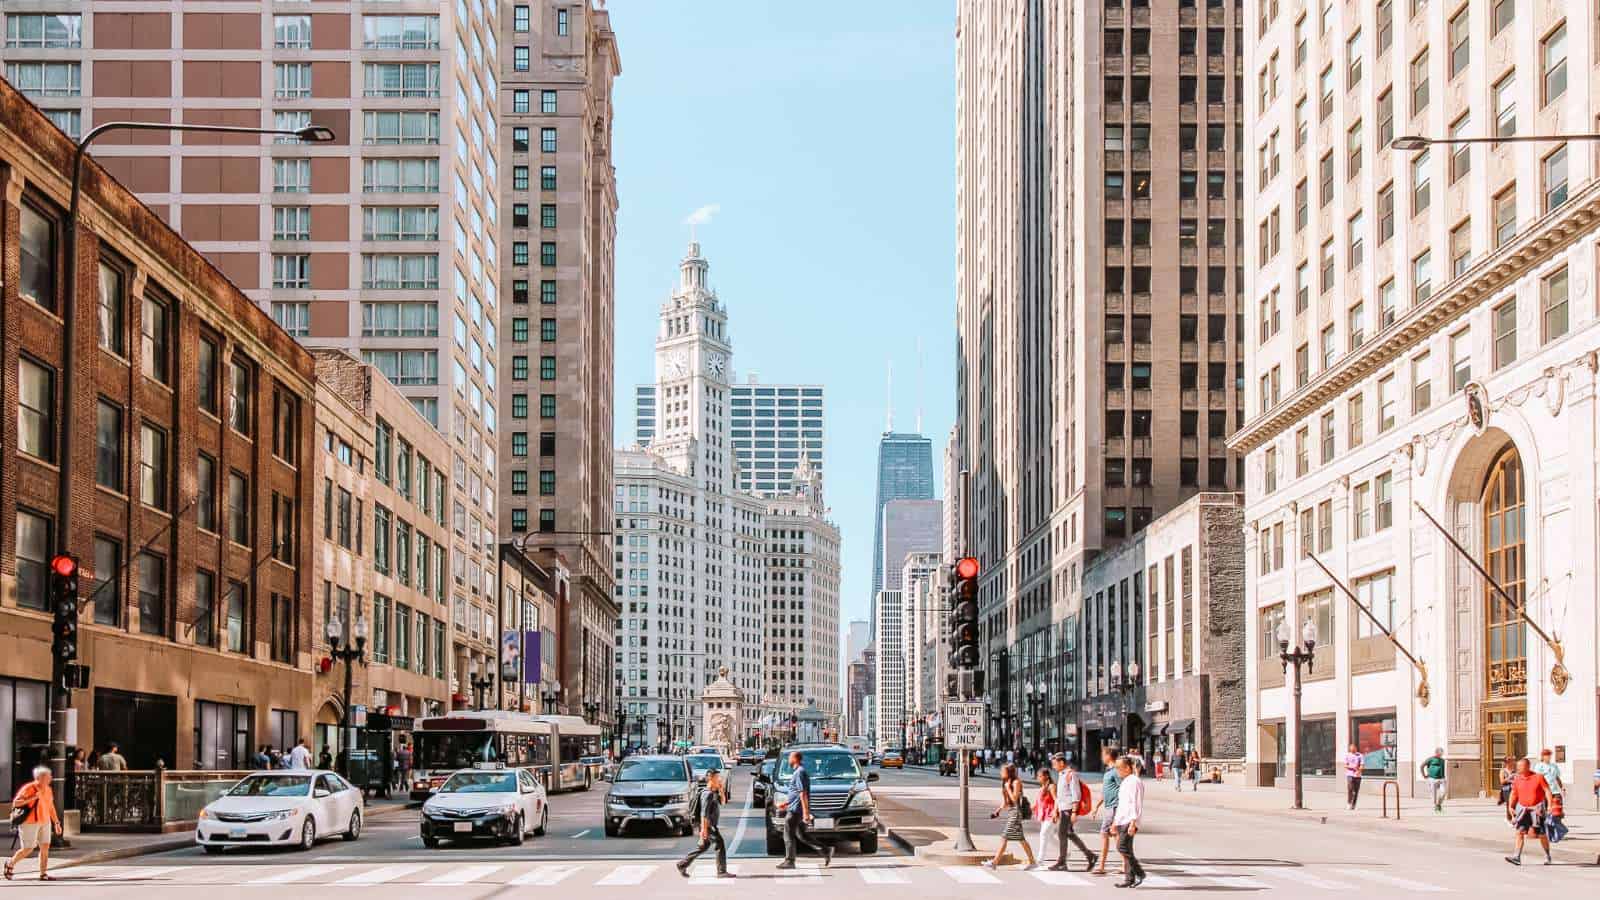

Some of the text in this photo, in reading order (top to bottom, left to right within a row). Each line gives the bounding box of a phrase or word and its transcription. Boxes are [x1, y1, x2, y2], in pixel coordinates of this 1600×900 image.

[949, 706, 982, 716] TURN LEFT
[960, 716, 970, 724] ON
[948, 724, 961, 734] LEFT
